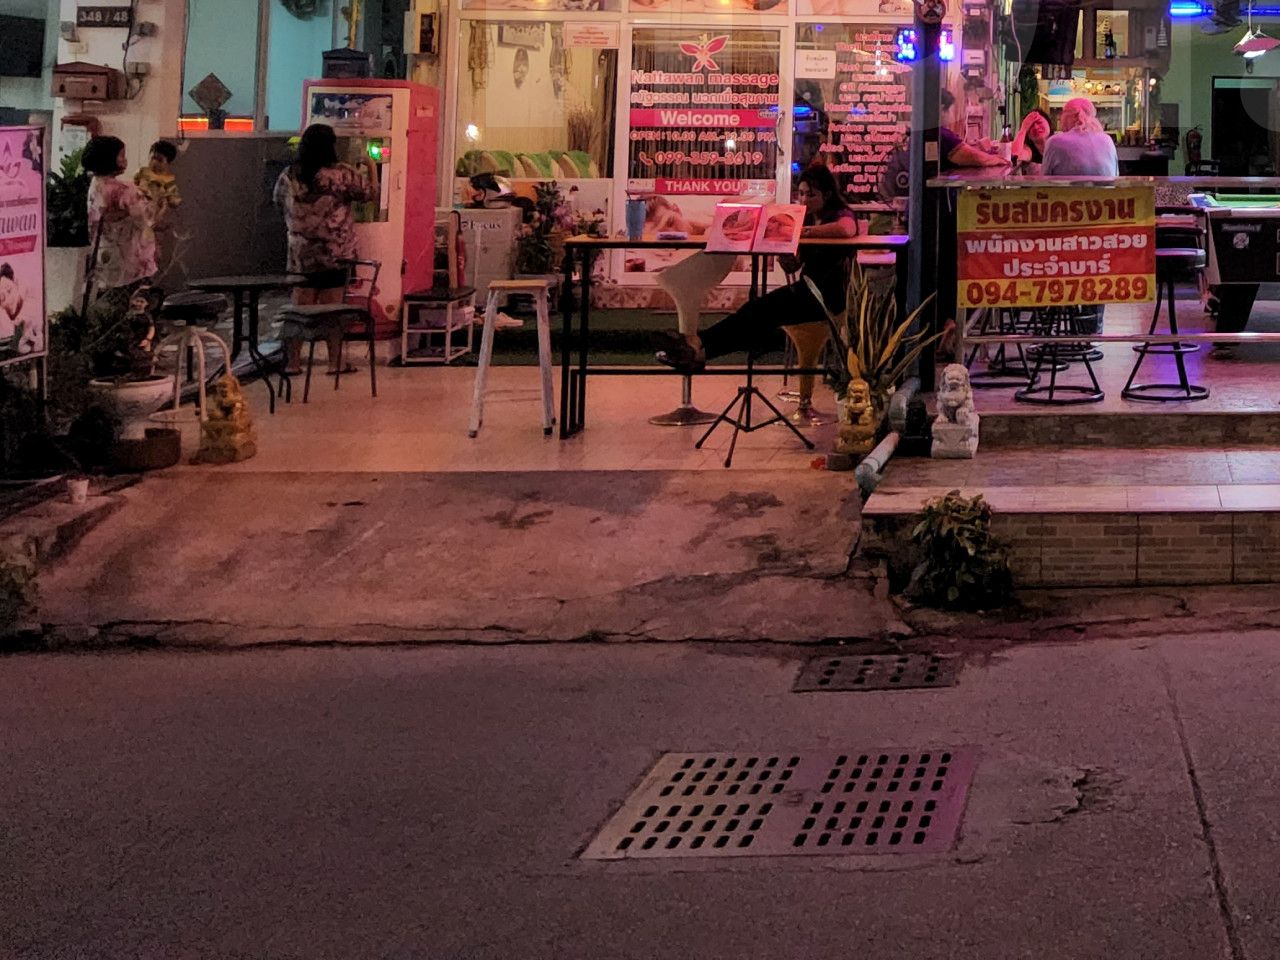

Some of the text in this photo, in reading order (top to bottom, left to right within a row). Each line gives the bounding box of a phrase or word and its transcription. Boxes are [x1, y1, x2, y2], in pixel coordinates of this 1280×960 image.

[630, 69, 779, 89] Nattawan massage
[660, 110, 741, 125] Welcome
[665, 180, 711, 192] THANK
[975, 191, 1136, 225] รับสมัครงาน
[1003, 253, 1111, 277] ประจำบาร์
[966, 276, 1148, 305] 094-7978289
